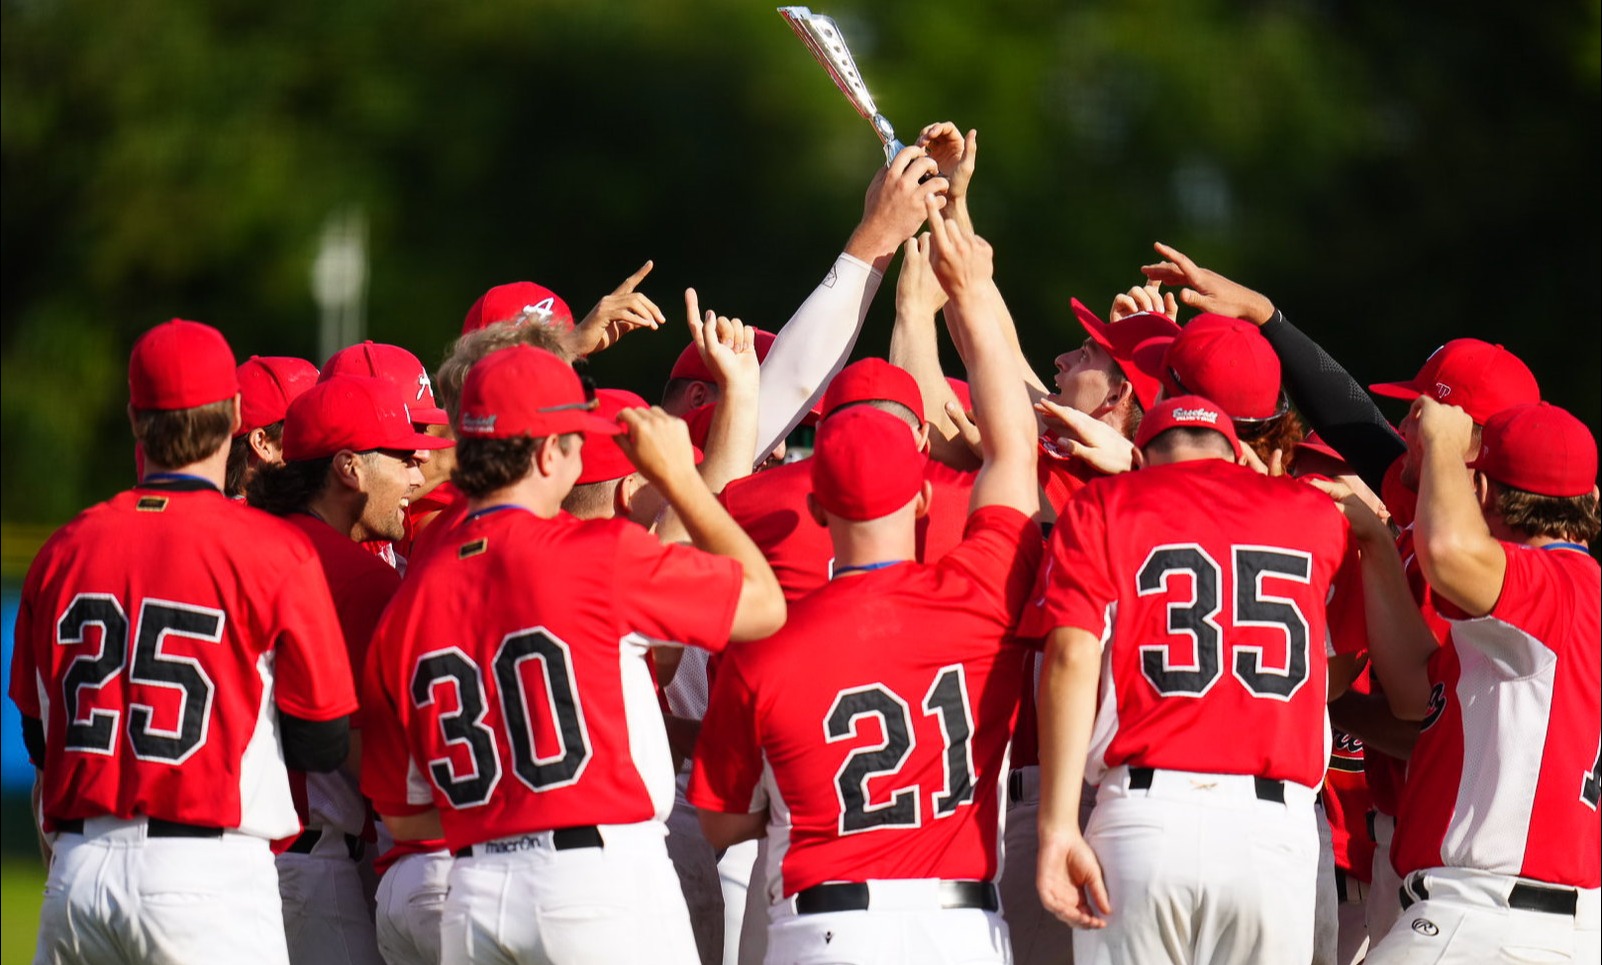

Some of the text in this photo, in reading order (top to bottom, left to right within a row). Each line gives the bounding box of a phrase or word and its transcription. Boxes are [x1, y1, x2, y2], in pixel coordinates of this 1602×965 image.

[57, 592, 226, 766] 25
[1136, 542, 1312, 702] 35
[410, 625, 593, 810] 30
[822, 662, 979, 836] 21
[486, 836, 541, 853] macron
